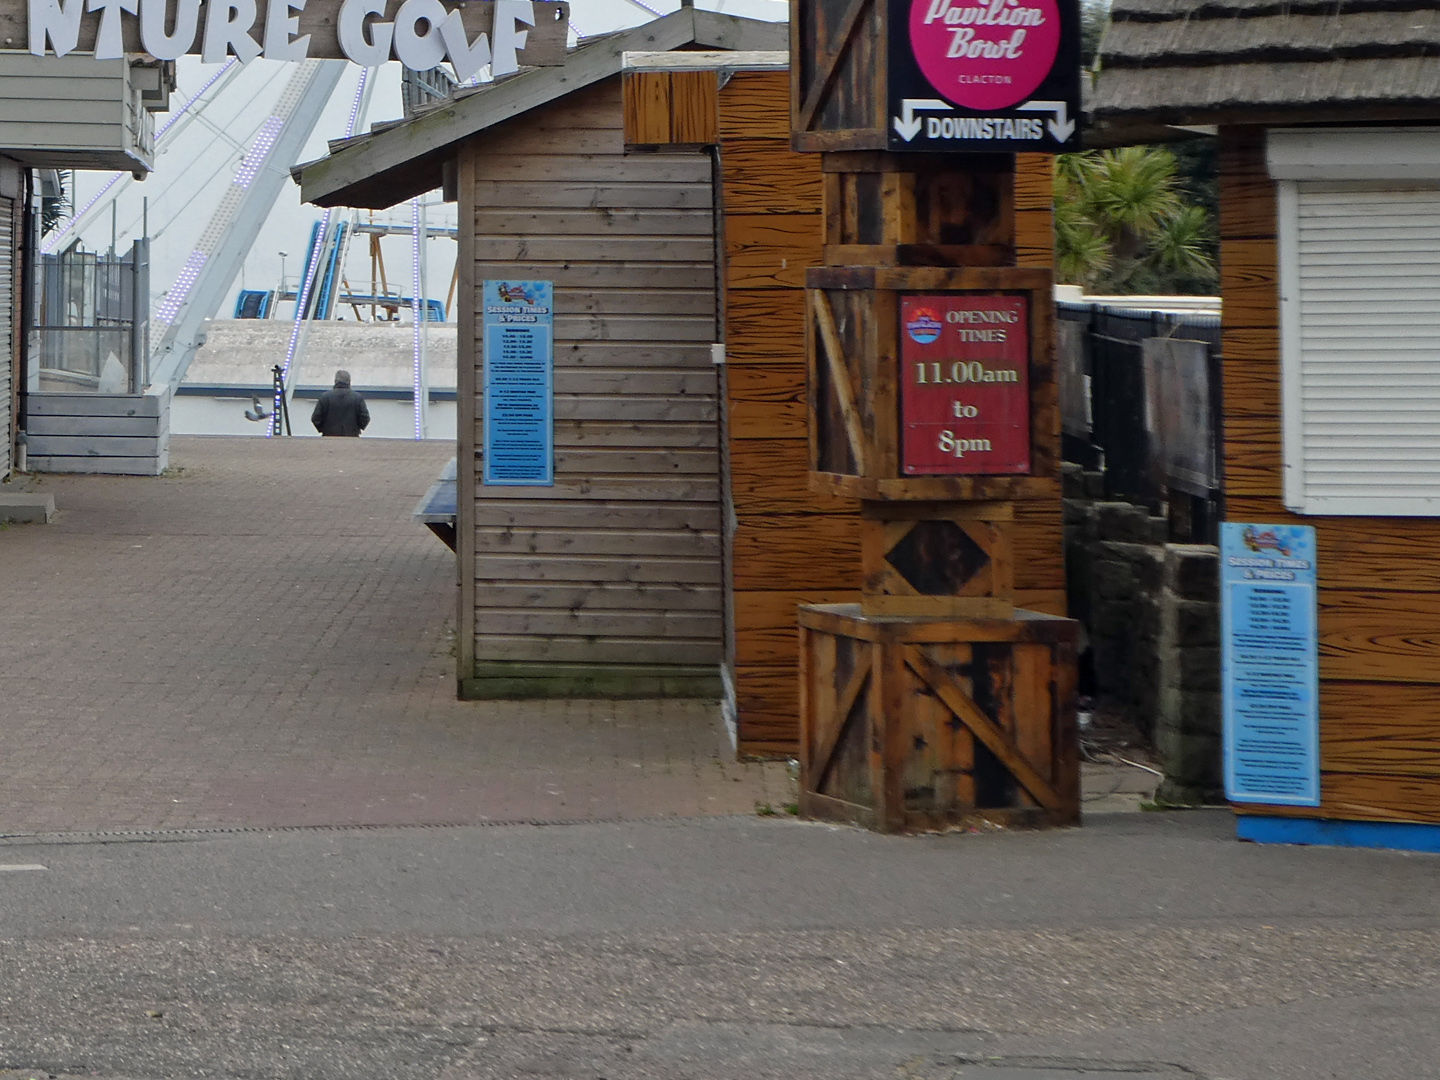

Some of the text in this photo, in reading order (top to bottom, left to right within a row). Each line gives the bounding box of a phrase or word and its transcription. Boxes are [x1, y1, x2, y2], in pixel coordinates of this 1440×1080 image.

[947, 27, 1027, 59] Bowl
[958, 75, 1012, 84] CLACTON
[927, 118, 1044, 140] DOWNSTAIRS
[946, 310, 1019, 324] OPENING
[959, 329, 1007, 342] TIMES
[916, 362, 1018, 384] 11.00am
[953, 400, 978, 418] to
[938, 430, 992, 458] 8pm
